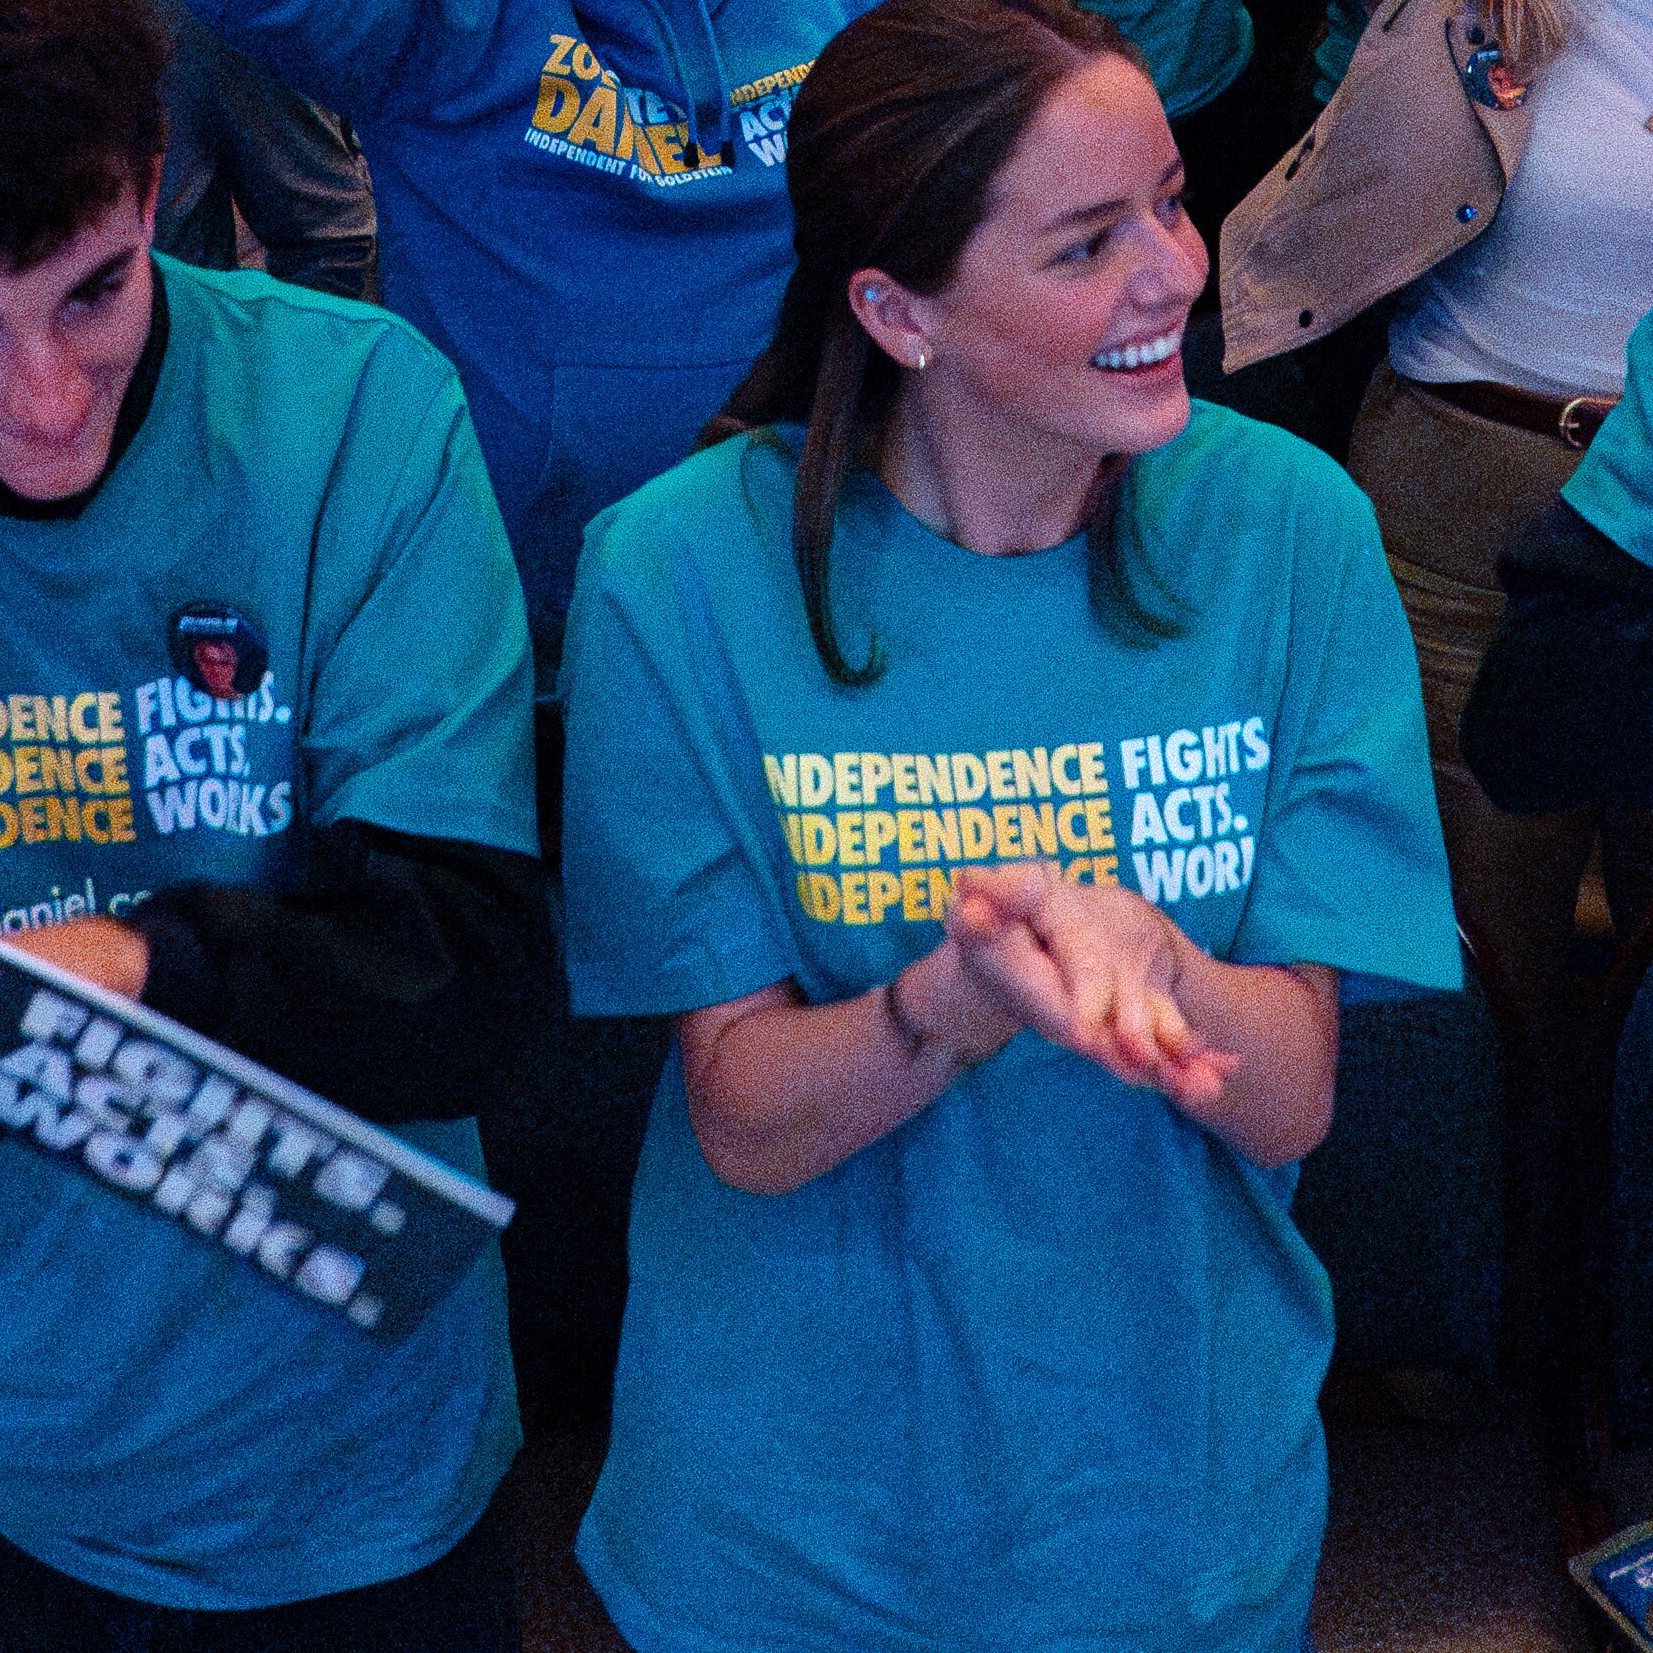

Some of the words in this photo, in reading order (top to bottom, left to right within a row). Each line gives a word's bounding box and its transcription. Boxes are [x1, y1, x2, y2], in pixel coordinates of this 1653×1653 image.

[543, 33, 616, 88] ZO
[524, 127, 626, 176] INDEPENDENT
[764, 742, 1109, 807] NDEPENDENCE
[1121, 717, 1271, 789] FIGHTS
[1131, 783, 1248, 846] ACTS.
